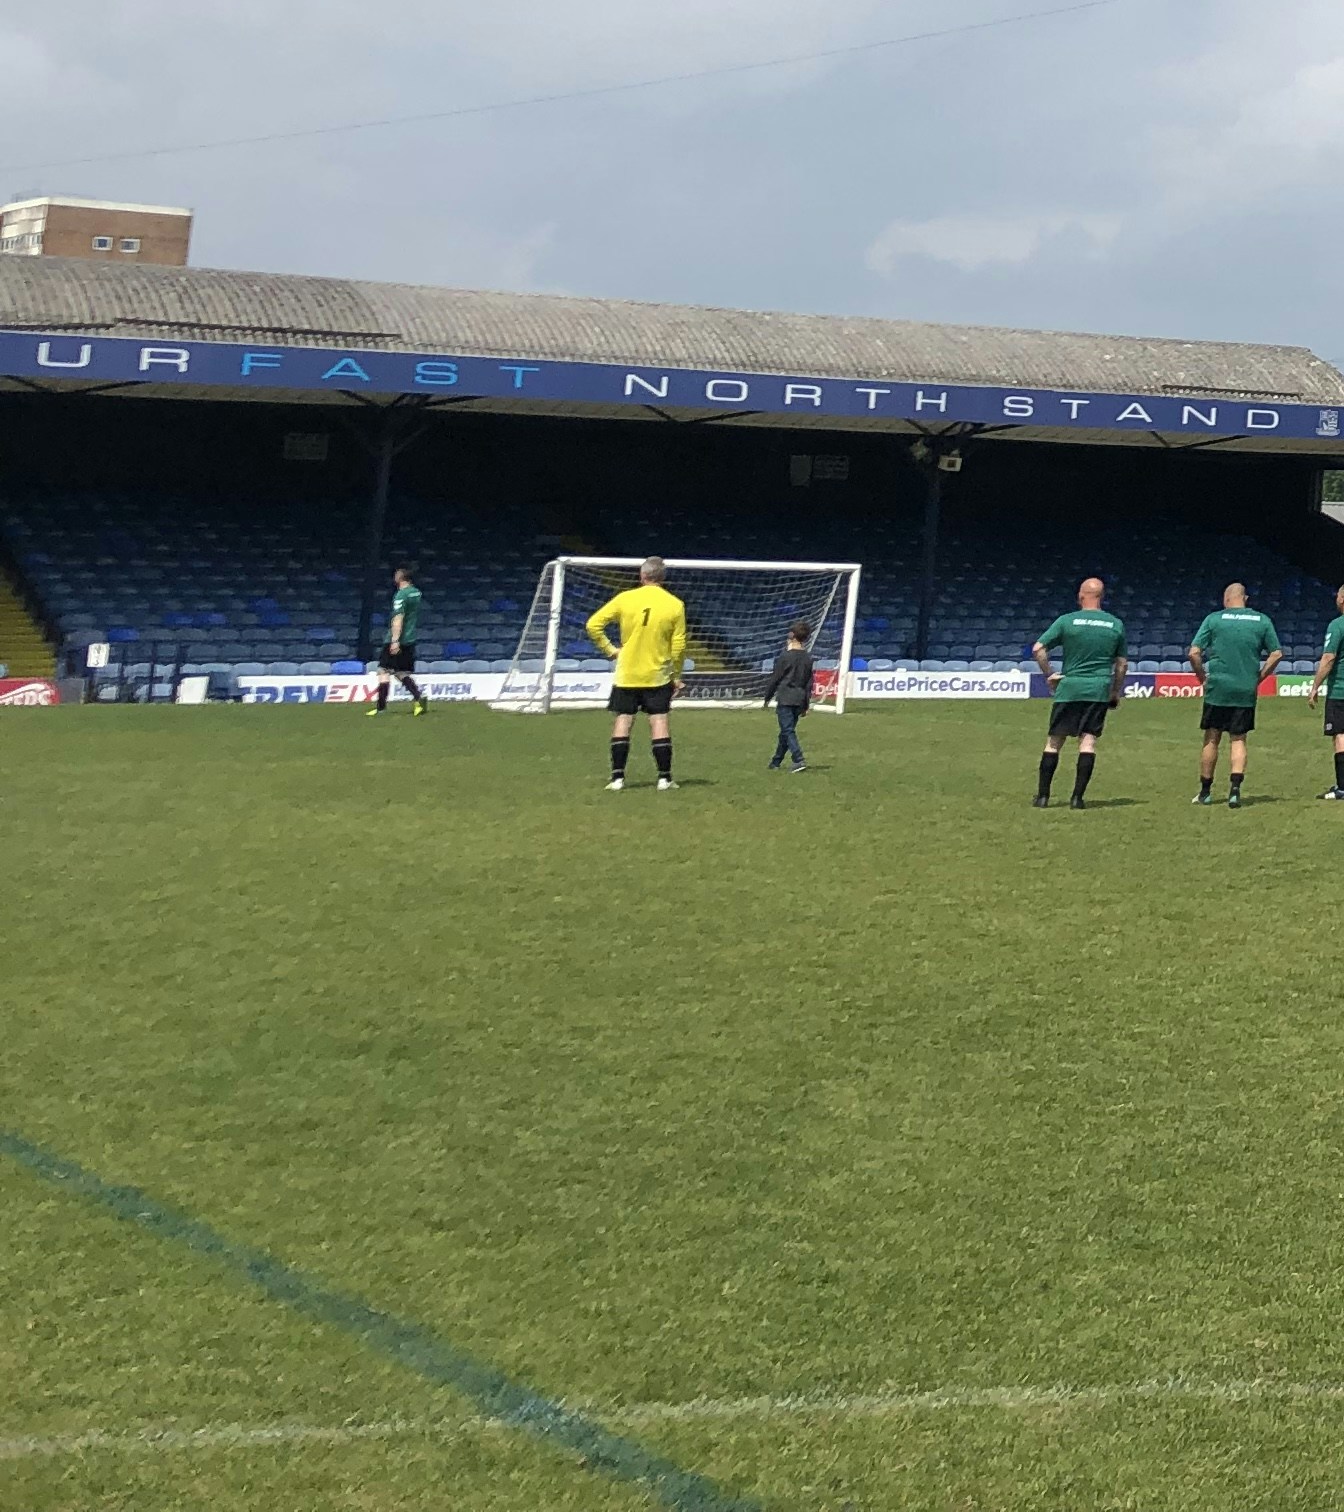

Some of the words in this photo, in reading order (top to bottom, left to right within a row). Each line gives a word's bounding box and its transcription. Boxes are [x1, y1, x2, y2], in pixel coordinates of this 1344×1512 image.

[624, 374, 947, 414] NORTH
[1003, 395, 1280, 429] STAND
[642, 608, 651, 627] 1
[857, 676, 1027, 693] TradePriceCars.com
[1124, 682, 1155, 698] sky
